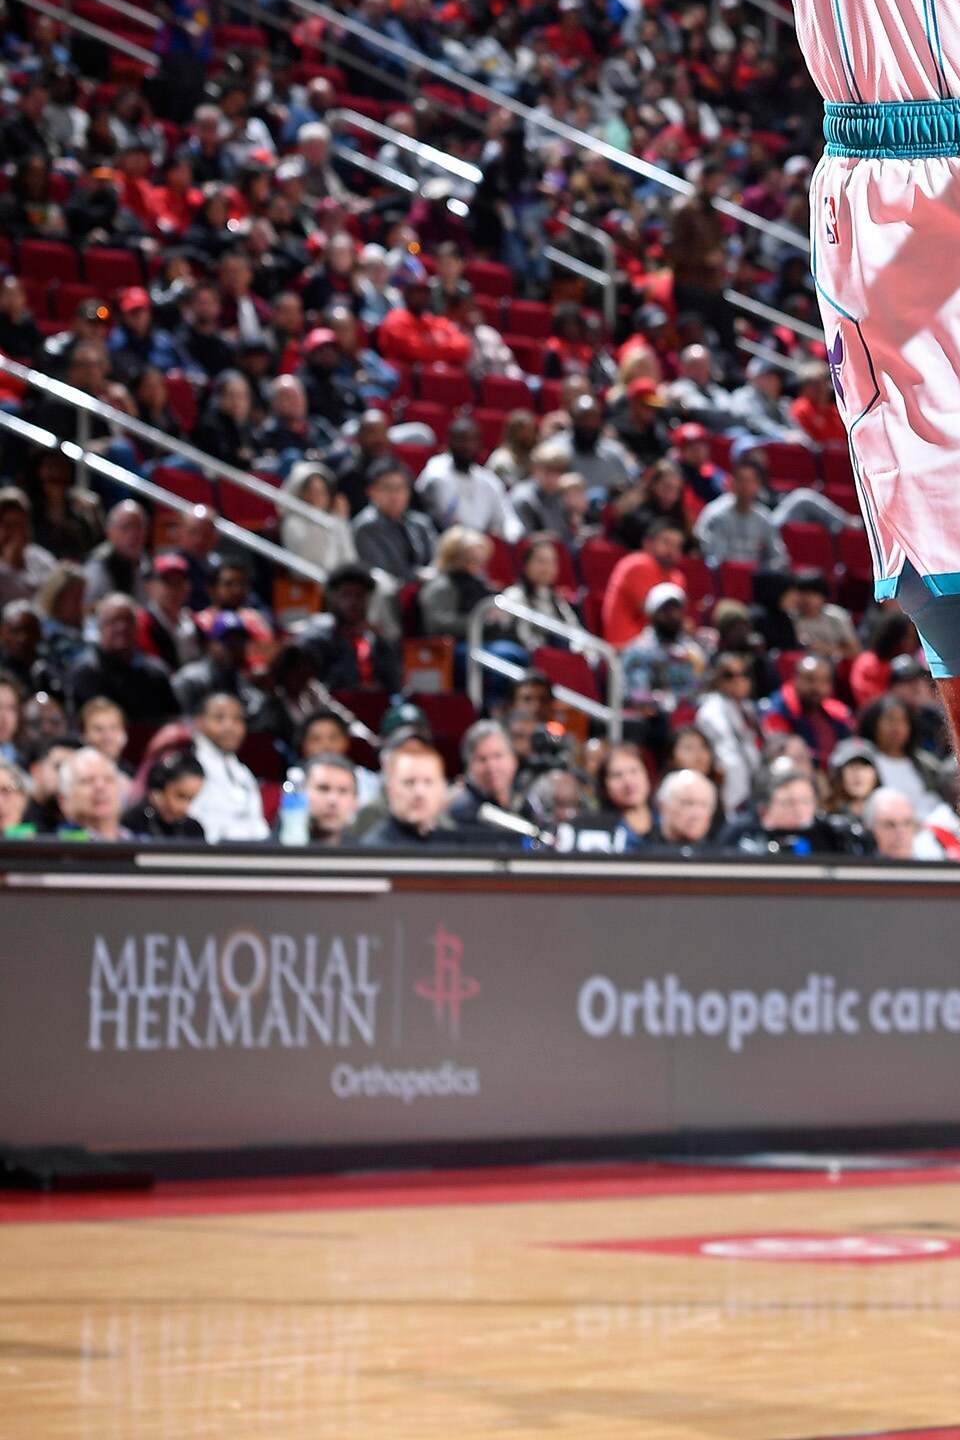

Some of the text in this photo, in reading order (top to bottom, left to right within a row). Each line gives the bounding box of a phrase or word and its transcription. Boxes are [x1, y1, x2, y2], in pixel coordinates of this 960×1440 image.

[89, 930, 379, 996] MEMORIAL
[87, 988, 378, 1050] HERMANN
[576, 972, 861, 1053] Orthopedic
[330, 1062, 482, 1105] Orthopedics
